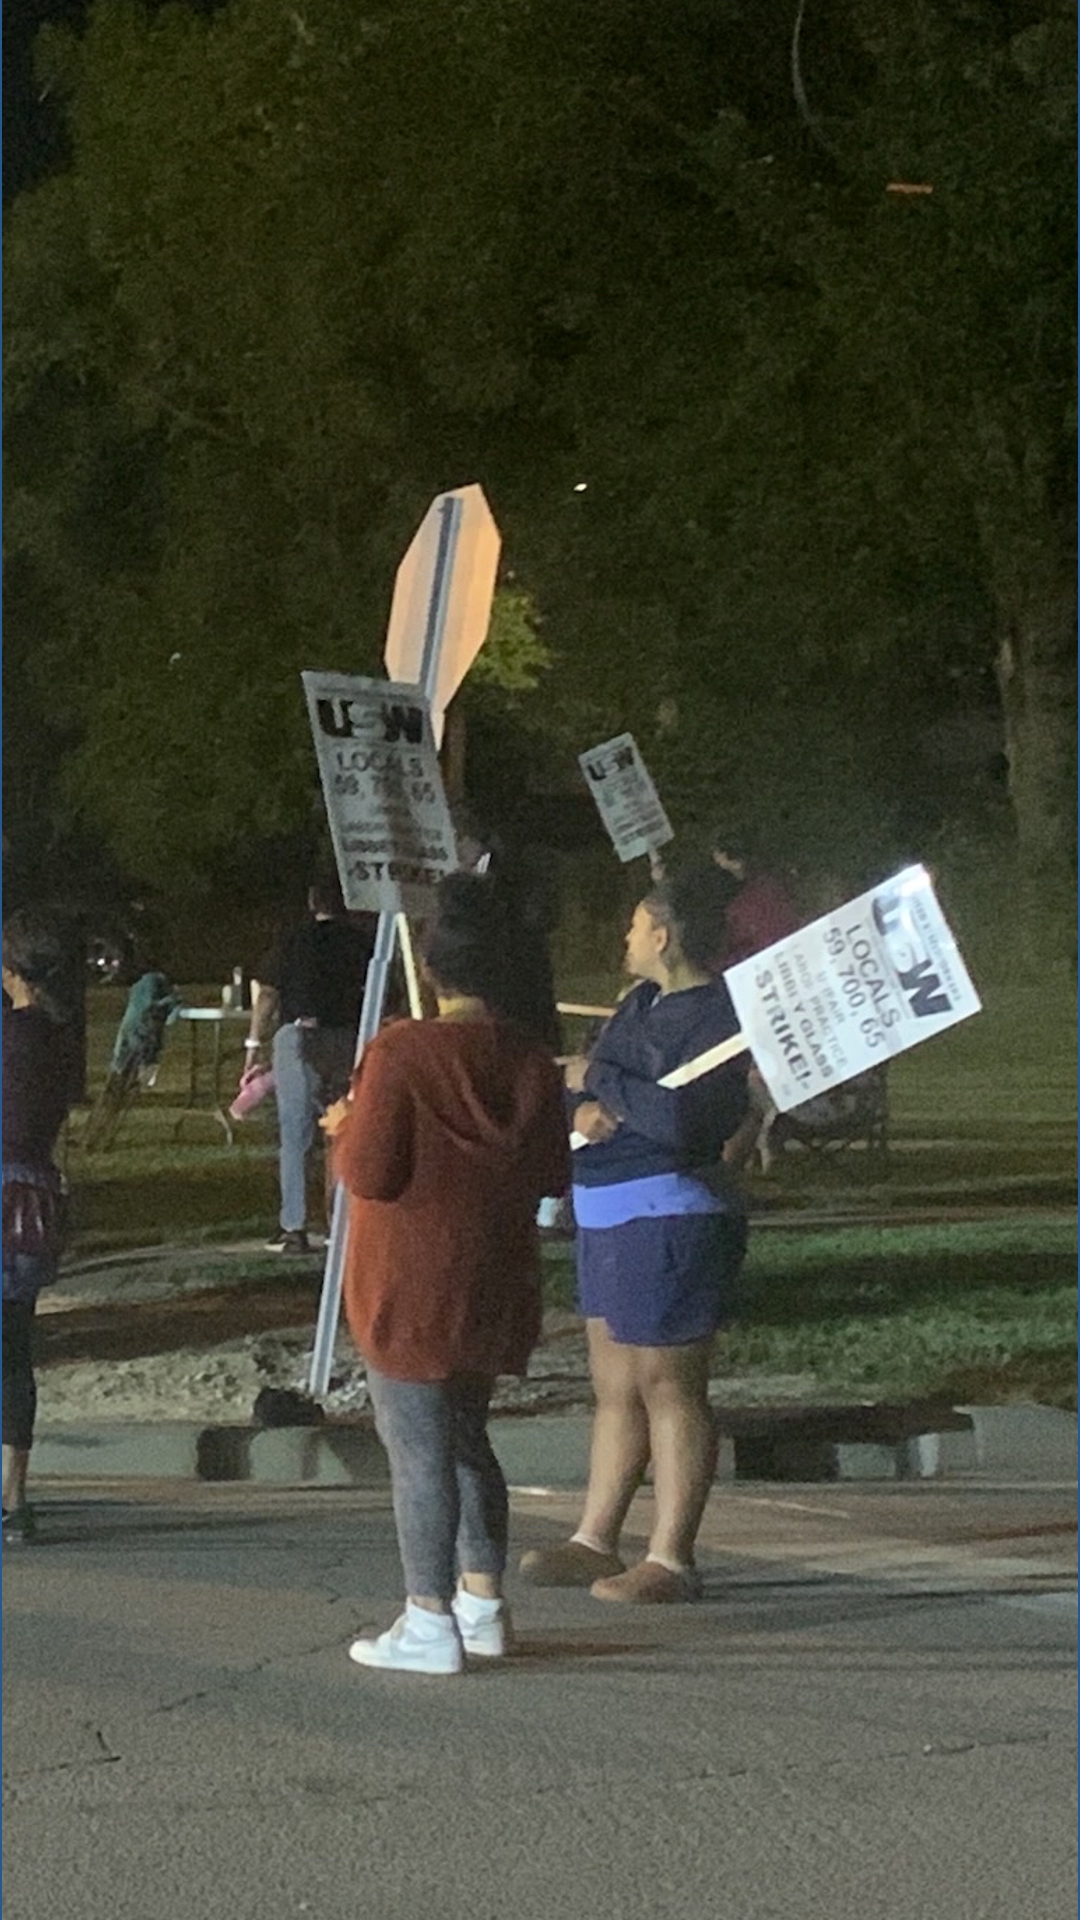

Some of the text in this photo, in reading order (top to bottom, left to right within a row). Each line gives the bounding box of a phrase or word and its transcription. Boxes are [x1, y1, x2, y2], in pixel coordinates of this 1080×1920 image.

[317, 699, 423, 744] USW
[837, 964, 866, 1018] 700,
[860, 1018, 886, 1048] 65
[846, 924, 902, 1029] LOCALS
[800, 1018, 834, 1079] GLASS
[809, 995, 848, 1067] PRACTICE
